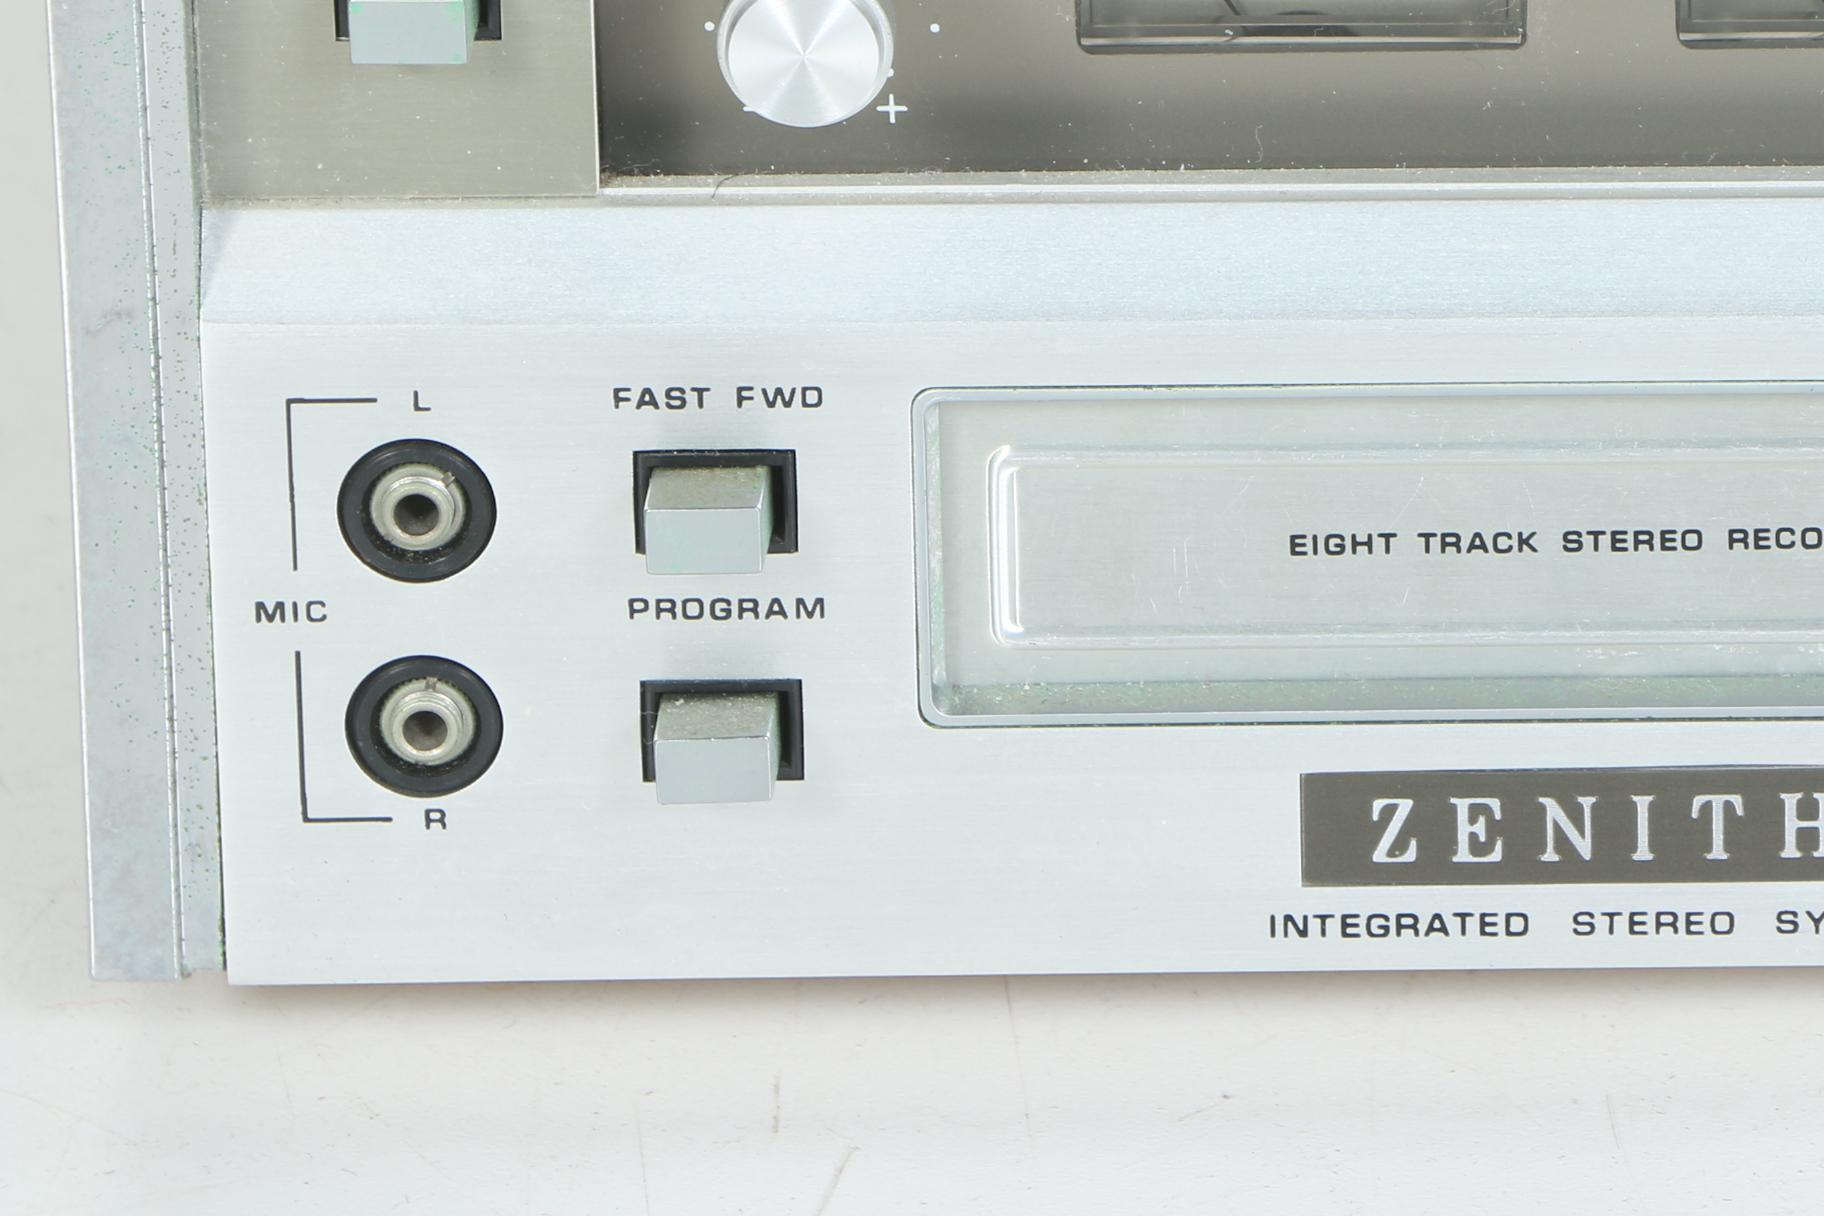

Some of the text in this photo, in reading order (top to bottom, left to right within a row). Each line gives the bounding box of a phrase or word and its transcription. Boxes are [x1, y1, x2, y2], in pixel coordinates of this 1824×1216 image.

[413, 390, 432, 412] L
[612, 385, 823, 410] FAST FWD
[1289, 532, 1398, 557] EIGHT
[1416, 531, 1539, 554] TRACK
[1562, 528, 1703, 553] STEREO
[254, 600, 328, 624] MIC
[627, 597, 825, 621] PROGRAM
[424, 808, 447, 830] R
[1269, 912, 1529, 939] INTEGRATED
[1572, 911, 1735, 937] STEREO
